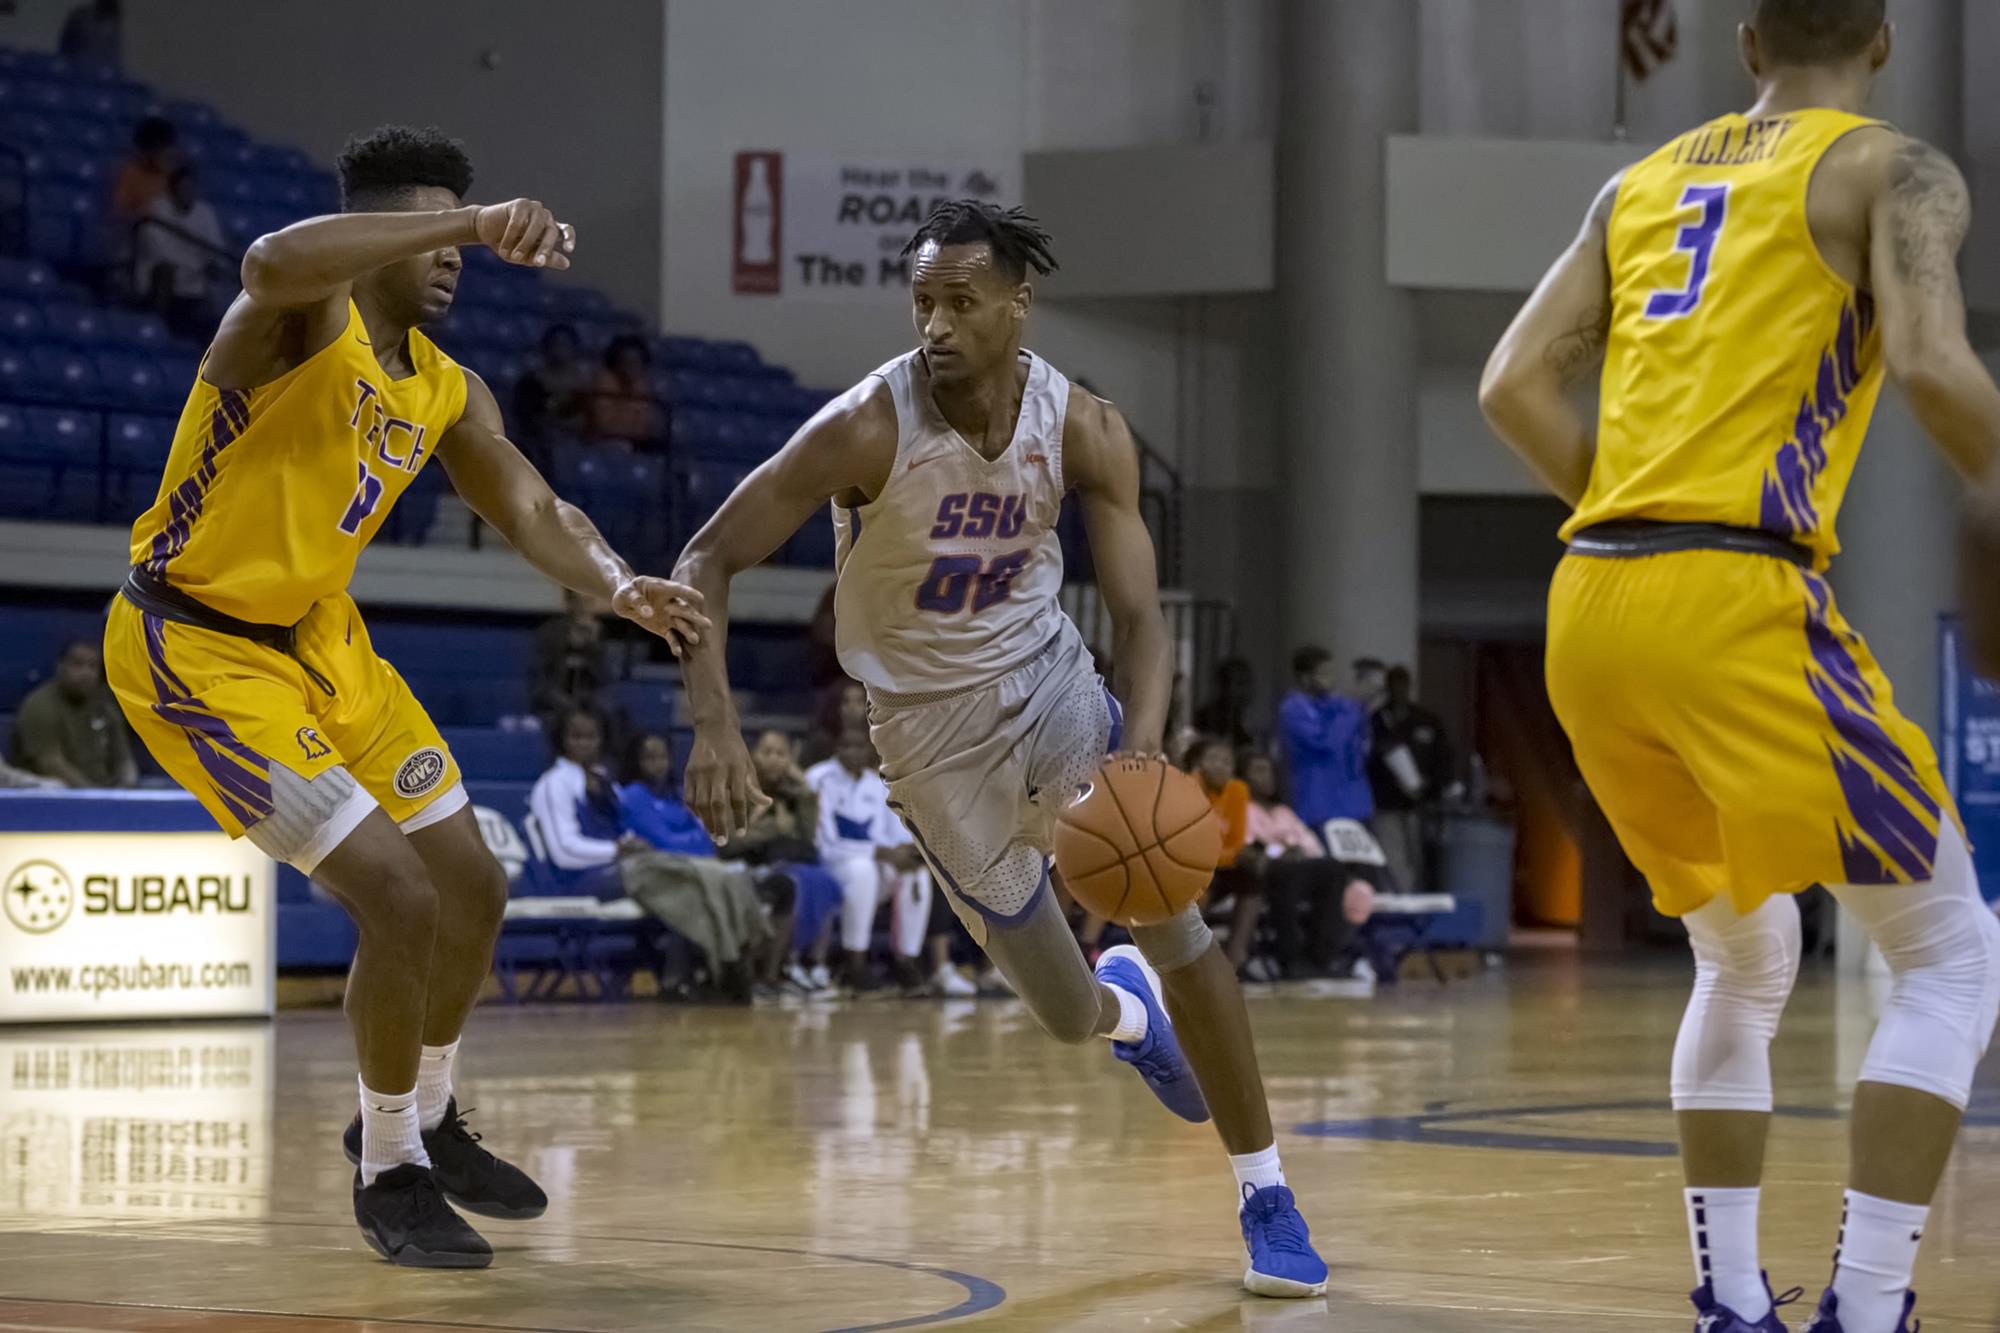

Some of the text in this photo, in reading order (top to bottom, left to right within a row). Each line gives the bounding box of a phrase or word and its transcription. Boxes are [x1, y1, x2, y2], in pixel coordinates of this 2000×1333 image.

[795, 254, 866, 287] The
[1643, 184, 1731, 320] 3
[929, 492, 1027, 540] SSU
[406, 758, 436, 788] OVC
[83, 874, 251, 915] SUBARU
[11, 956, 250, 1000] www.cpsubaru.com
